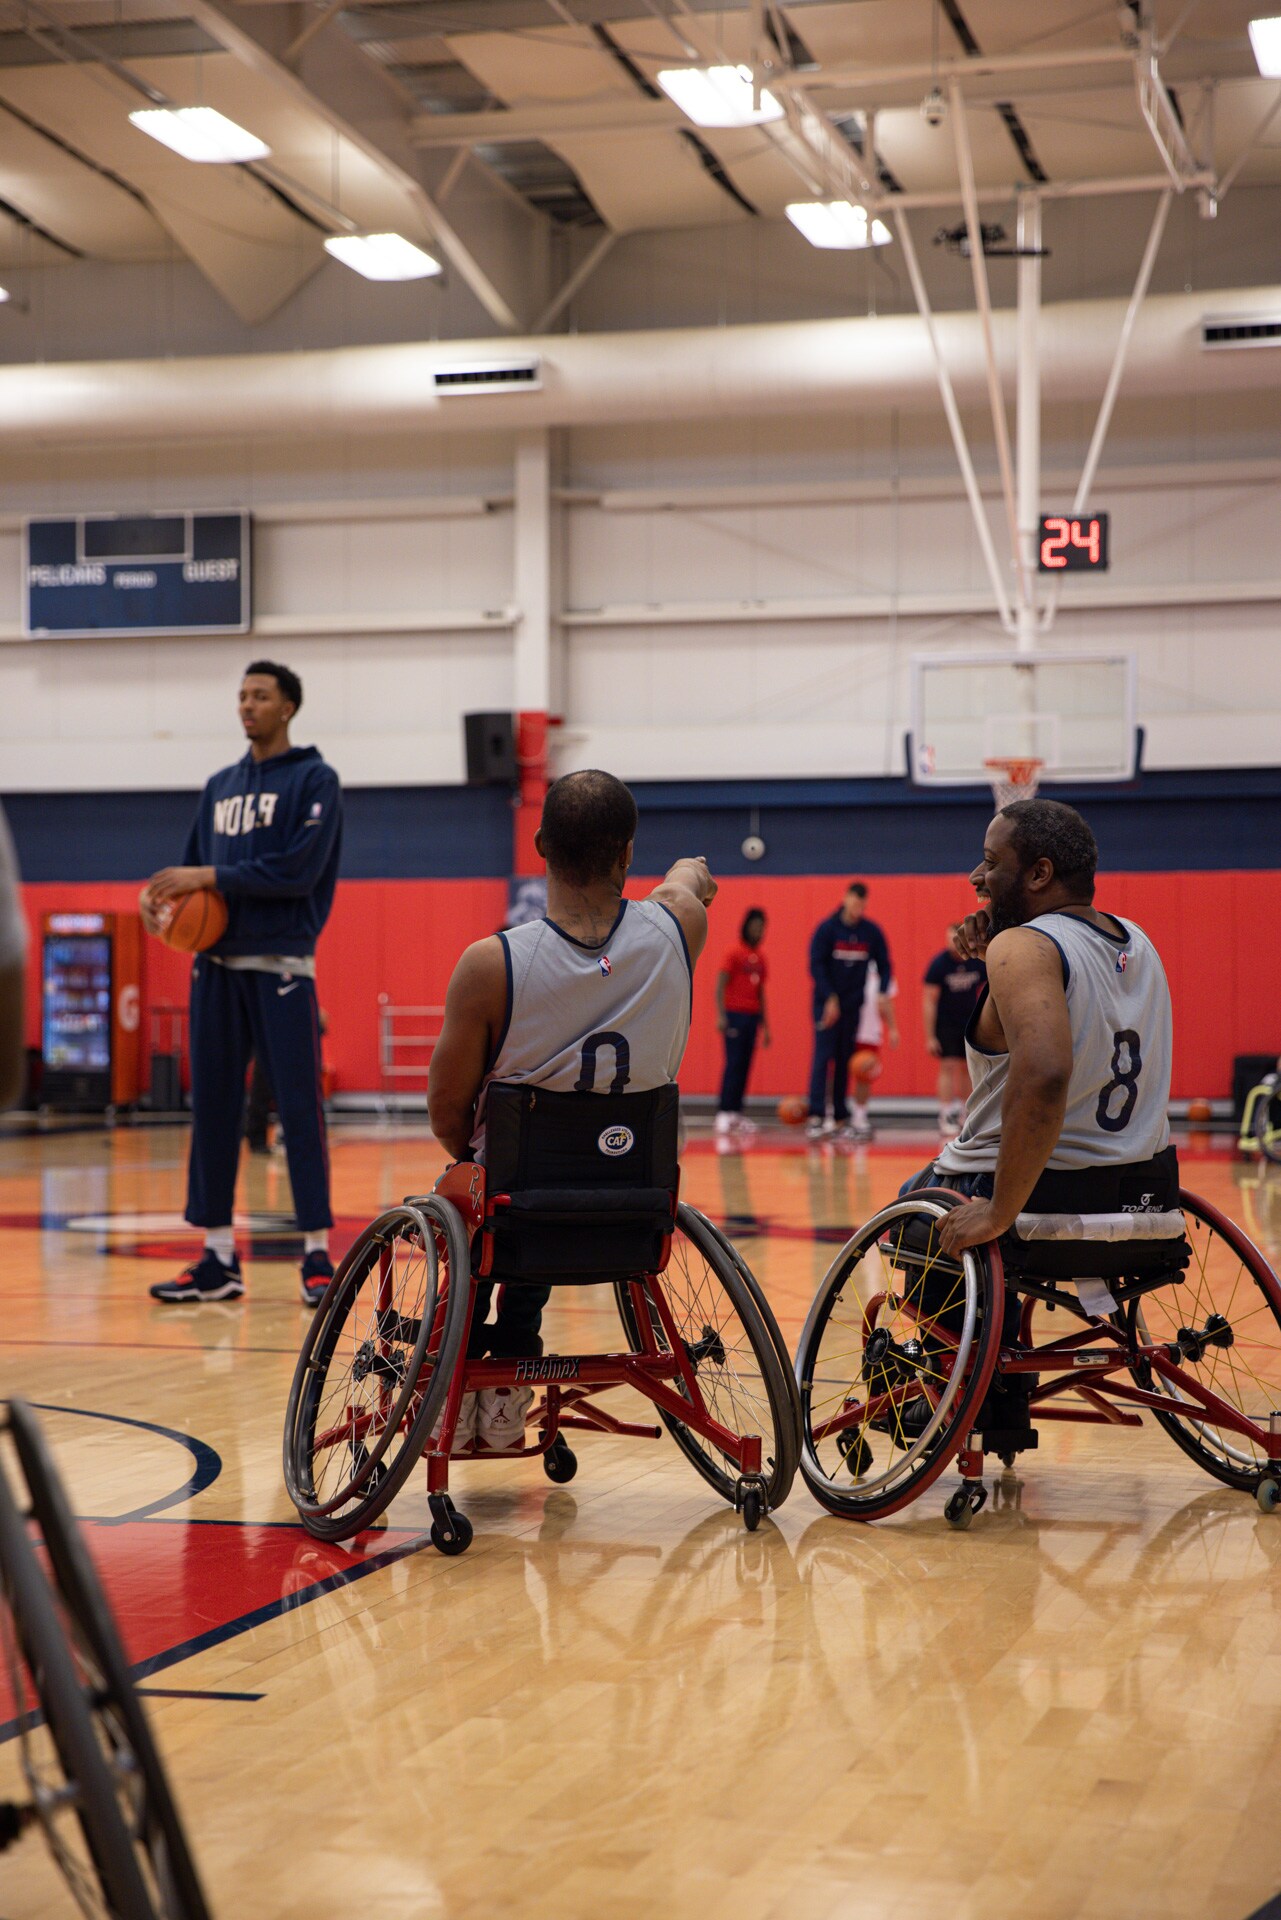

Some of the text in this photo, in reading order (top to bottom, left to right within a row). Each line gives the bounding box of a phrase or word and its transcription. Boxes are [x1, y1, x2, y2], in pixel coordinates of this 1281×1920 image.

[1041, 518, 1100, 568] 24
[182, 558, 240, 583] GUEST
[1096, 1028, 1142, 1132] 8
[607, 1136, 626, 1146] CAF
[1121, 1204, 1163, 1213] TOP END
